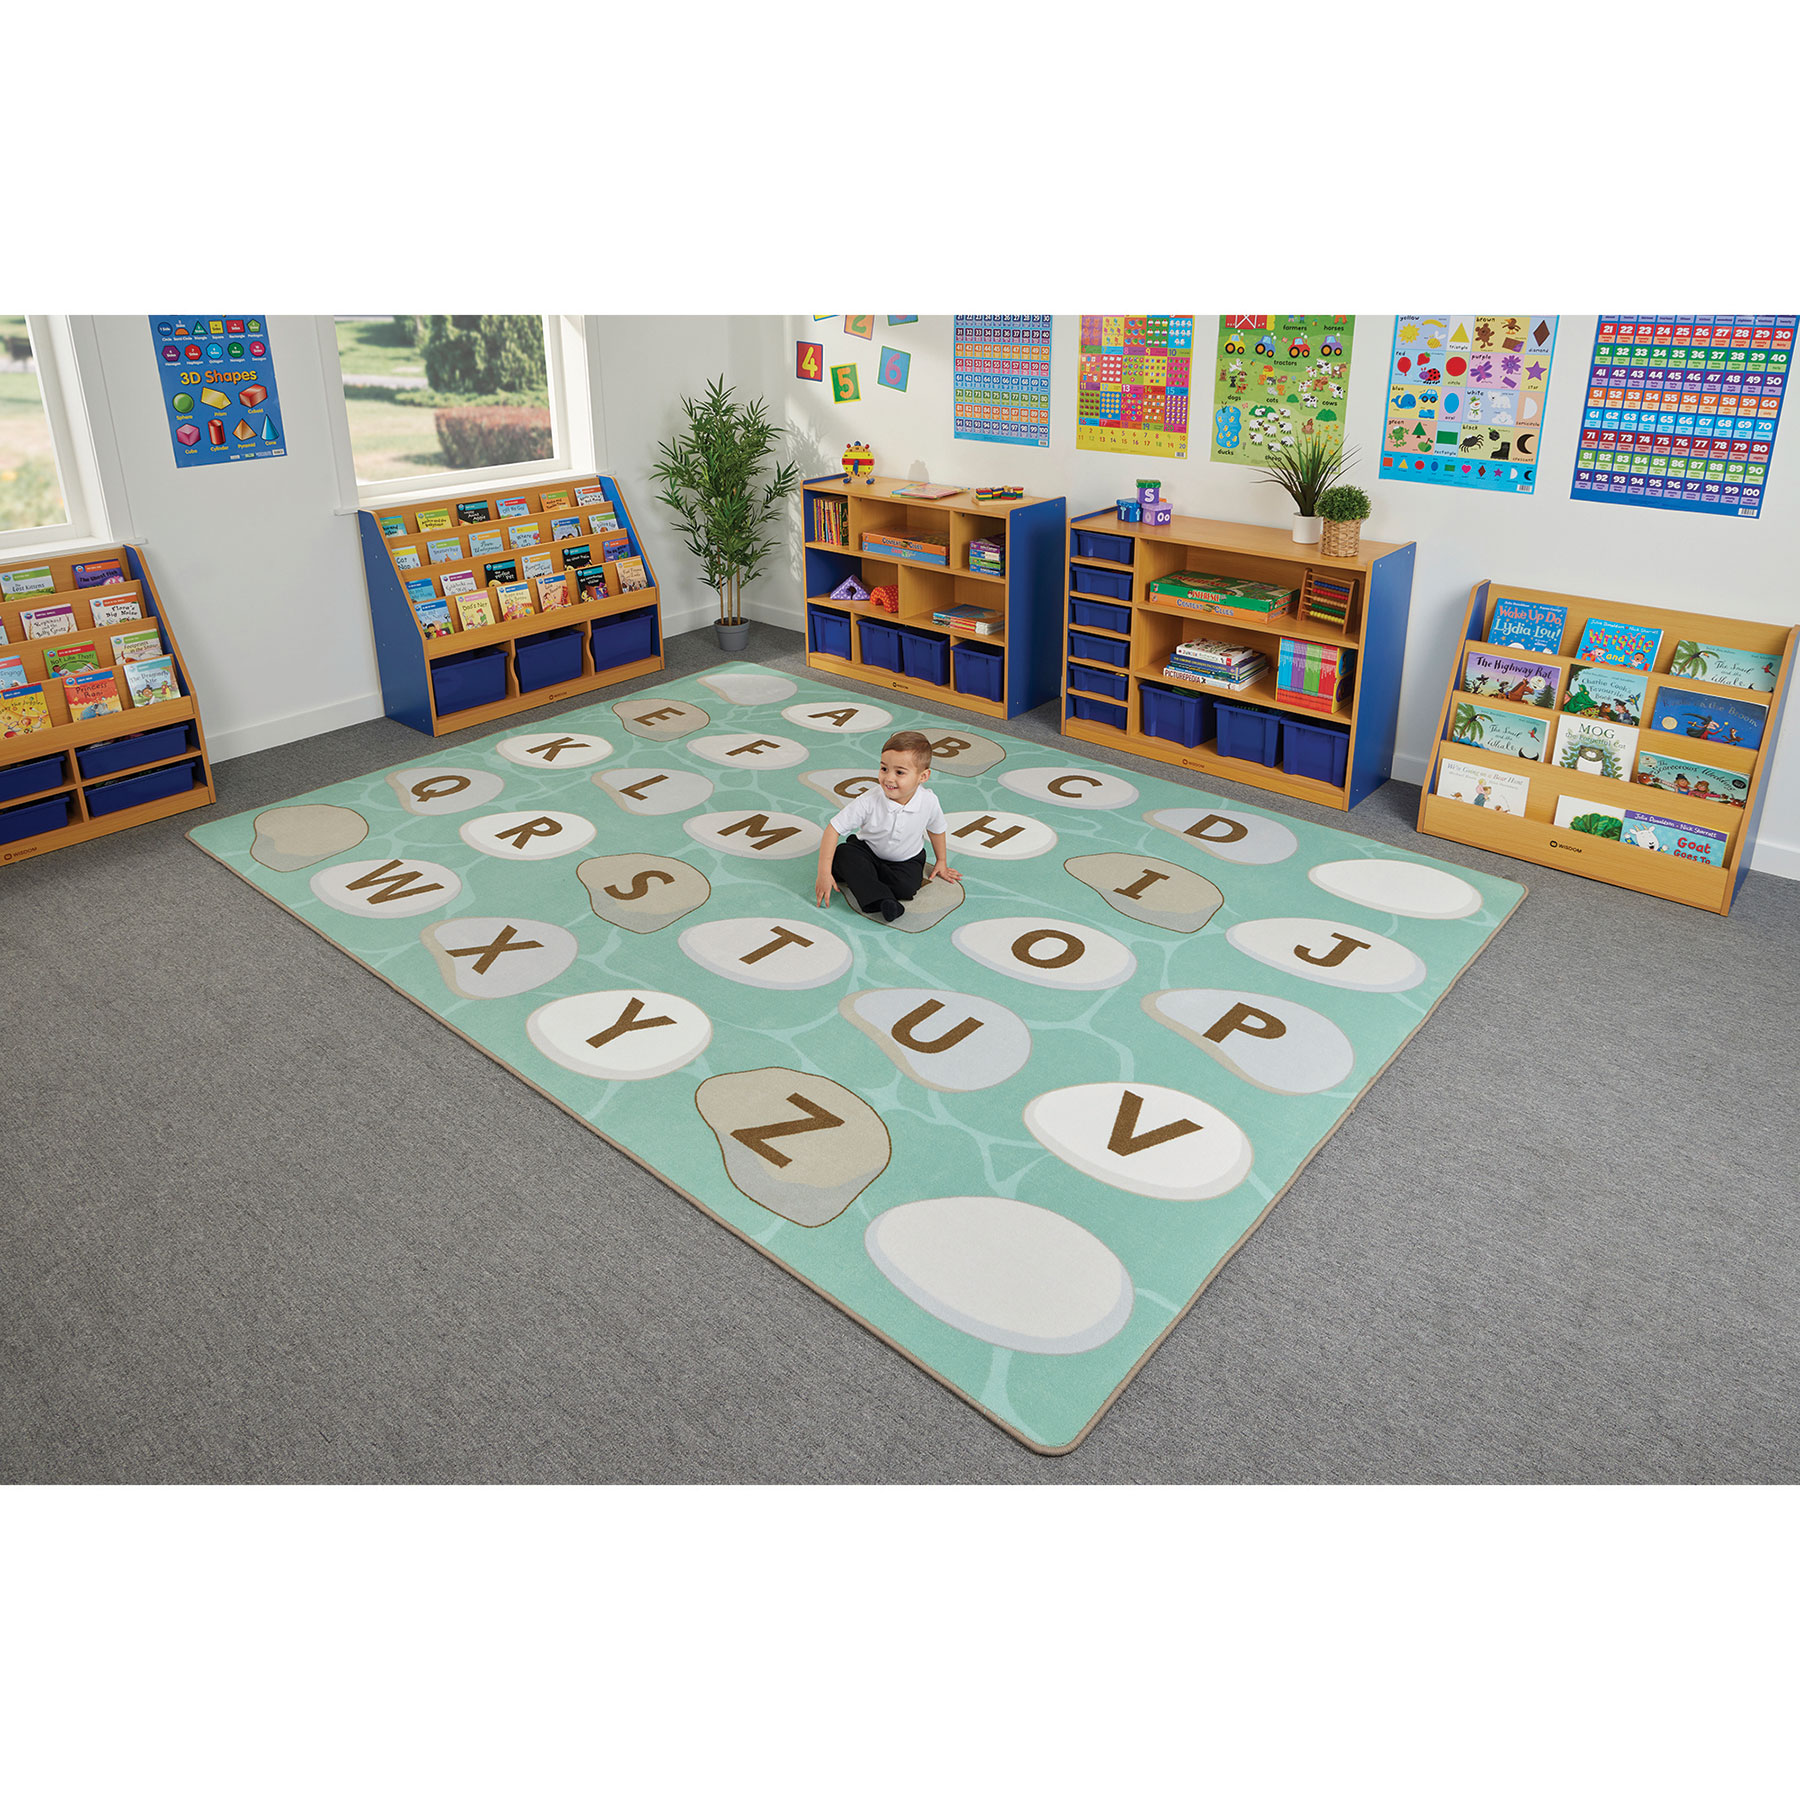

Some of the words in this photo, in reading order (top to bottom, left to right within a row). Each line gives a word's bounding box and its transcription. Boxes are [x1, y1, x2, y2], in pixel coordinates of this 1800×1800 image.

[851, 315, 866, 334] 2
[1603, 325, 1613, 333] 21
[1638, 326, 1652, 334] 23
[1657, 327, 1670, 335] 24
[1676, 328, 1689, 336] 25
[1695, 328, 1709, 336] 26
[1715, 328, 1730, 336] 27
[1735, 329, 1749, 337] 28
[1755, 330, 1770, 338] 29
[1776, 331, 1791, 339] 30
[802, 347, 818, 378] 4
[885, 353, 902, 385] 6
[180, 372, 201, 384] 3D
[205, 370, 258, 384] Shapes
[837, 368, 854, 398] 5
[1123, 384, 1130, 392] 13
[1145, 489, 1154, 502] S
[1649, 479, 1662, 487] 95
[1668, 481, 1680, 489] 96
[1725, 486, 1739, 494] 99
[1743, 488, 1760, 496] 100
[1500, 606, 1527, 619] Wake
[1529, 610, 1544, 624] Up
[1494, 619, 1531, 636] Lydia
[1534, 626, 1561, 641] Lou!
[1589, 628, 1654, 655] Wriggle
[1477, 657, 1492, 668] The
[1494, 660, 1534, 678] Highway
[1535, 667, 1552, 679] Rat
[1606, 654, 1624, 662] and
[1165, 670, 1200, 682] PICTUREPEDIA
[1582, 678, 1608, 686] Charlie
[76, 683, 107, 692] Princess
[633, 707, 685, 726] E
[808, 708, 859, 727] A
[1728, 707, 1758, 728] Broom
[1579, 724, 1614, 738] MOG
[527, 737, 590, 762] K
[726, 740, 781, 757] F
[932, 736, 971, 758] B
[1614, 741, 1626, 750] Cat
[411, 776, 471, 802] Q
[619, 775, 669, 801] L
[834, 776, 880, 799] G
[1048, 775, 1103, 799] C
[1493, 774, 1506, 782] Bear
[496, 816, 563, 850] R
[717, 813, 802, 851] M
[951, 815, 1025, 849] H
[1184, 814, 1249, 844] D
[1649, 816, 1674, 827] Donaldson
[1680, 824, 1693, 832] Nick
[1559, 844, 1582, 854] WISDOM
[1678, 837, 1711, 854] Goat
[1674, 850, 1698, 862] Goes
[1700, 856, 1711, 864] To
[346, 860, 445, 905] W
[604, 870, 676, 901] S
[1113, 868, 1171, 901] I
[446, 925, 545, 975] X
[740, 925, 814, 965] T
[1012, 929, 1086, 969] O
[1294, 932, 1371, 968] J
[586, 998, 677, 1049] Y
[892, 998, 985, 1054] U
[1203, 1002, 1287, 1044] P
[730, 1092, 846, 1169] Z
[1108, 1090, 1203, 1157] V
